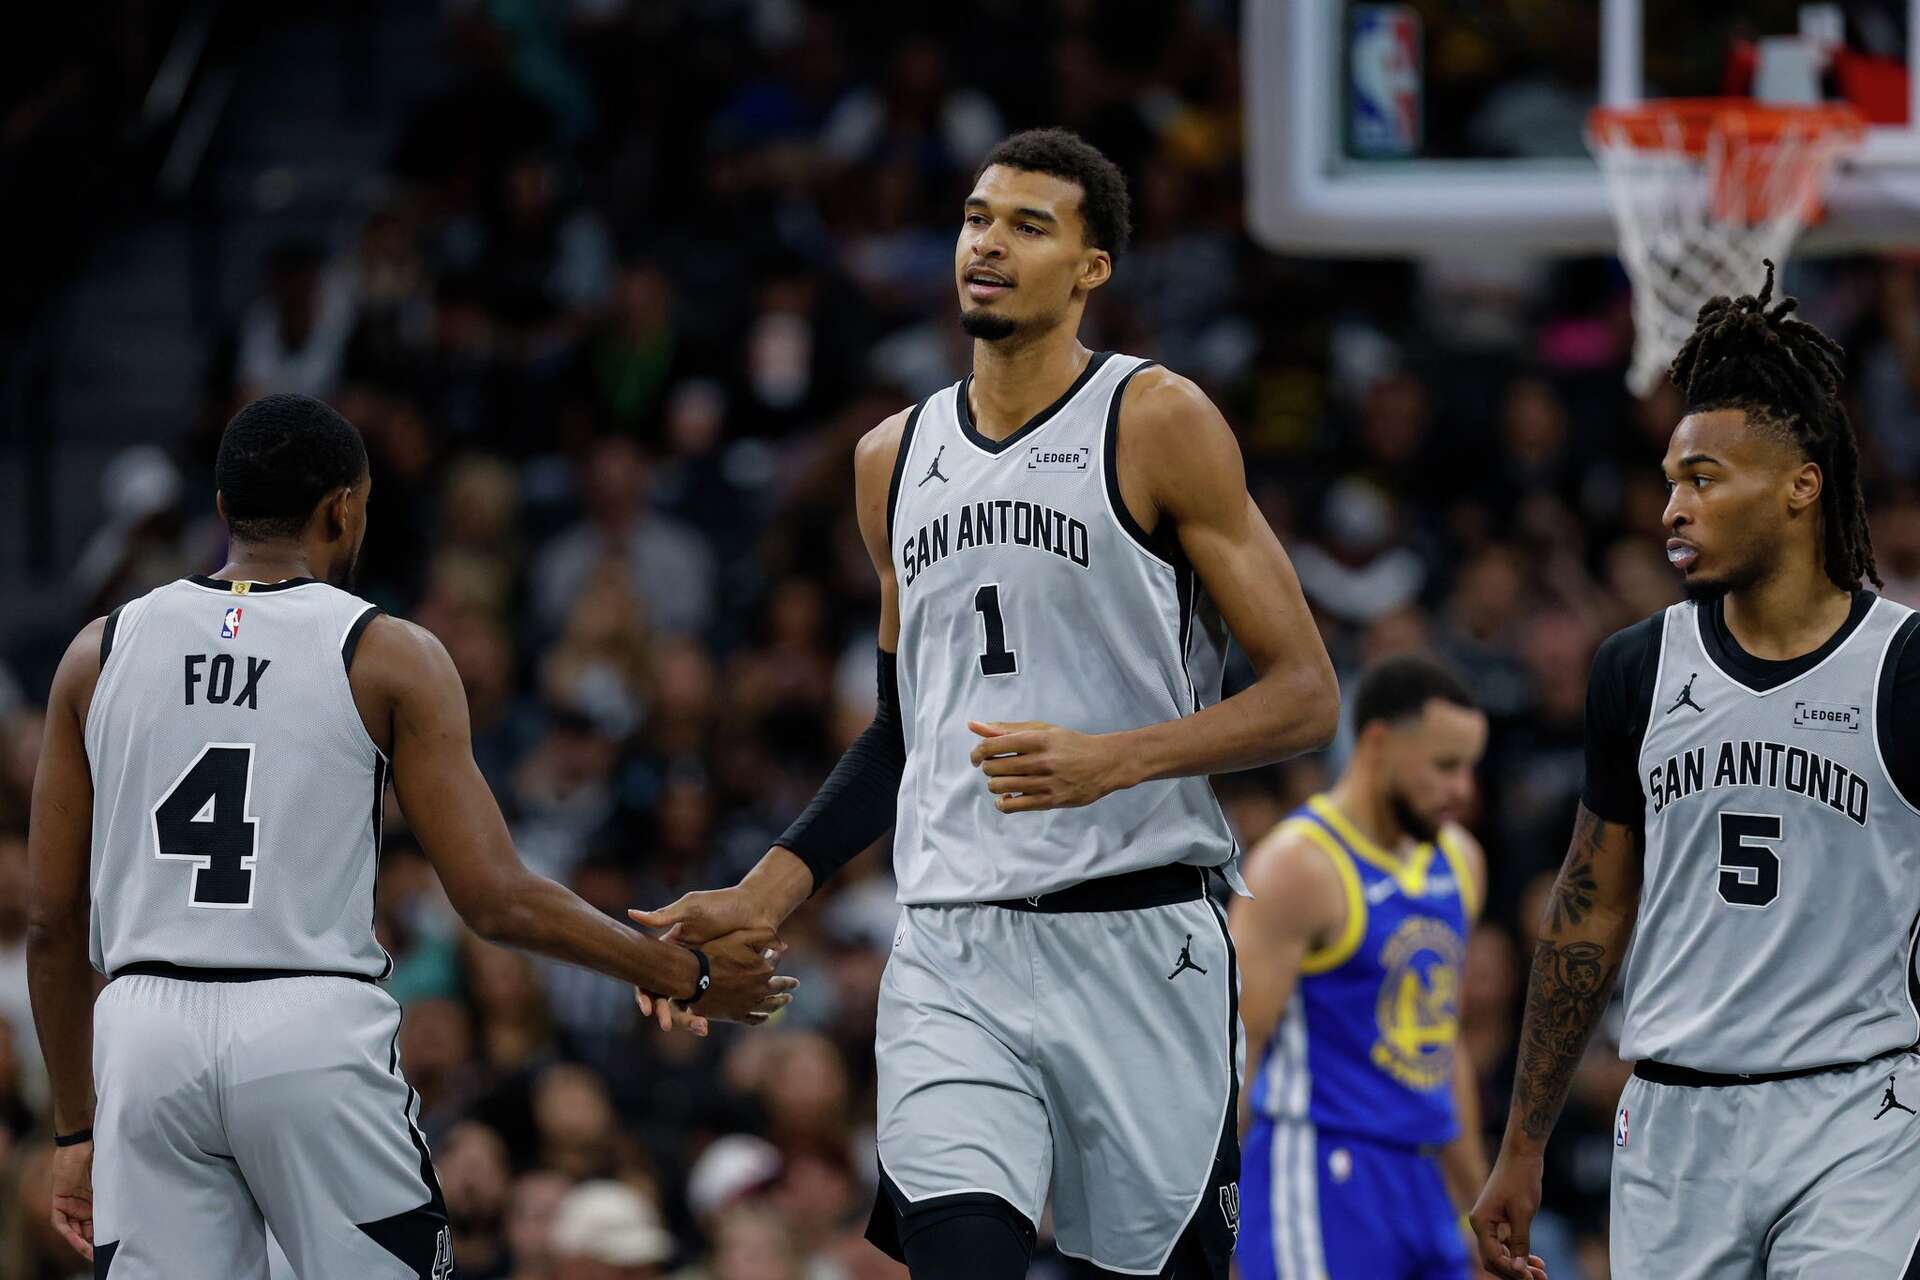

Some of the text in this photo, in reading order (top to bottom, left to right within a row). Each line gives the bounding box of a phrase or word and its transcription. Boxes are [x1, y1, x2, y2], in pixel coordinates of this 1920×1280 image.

[1036, 454, 1080, 463] LEDGER
[903, 500, 1089, 588] SAN ANTONIO
[974, 583, 1019, 677] 1
[184, 653, 271, 711] FOX
[1802, 709, 1851, 723] LEDGER
[150, 742, 260, 908] 4
[1649, 741, 1869, 827] SAN ANTONIO
[1717, 811, 1782, 907] 5
